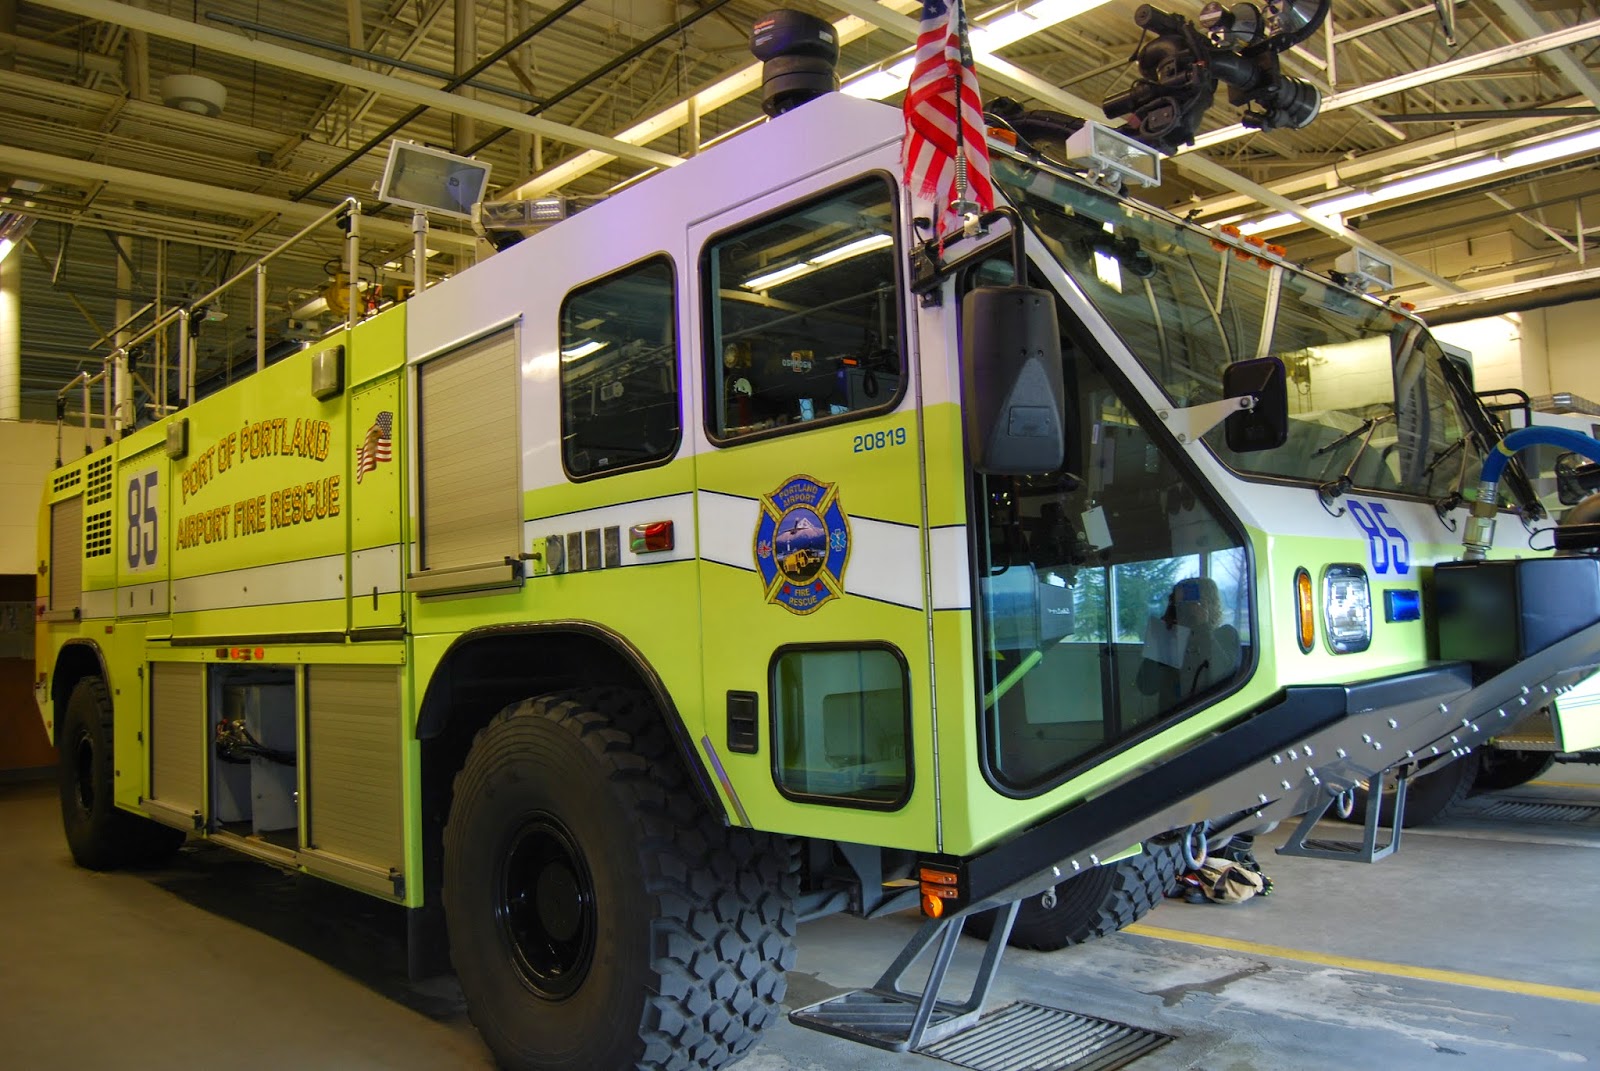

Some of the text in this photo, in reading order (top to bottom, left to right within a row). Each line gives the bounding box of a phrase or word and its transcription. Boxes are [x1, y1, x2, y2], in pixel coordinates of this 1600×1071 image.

[854, 427, 906, 453] 20819
[182, 418, 331, 505] PORT OF PORTLAND
[779, 483, 818, 499] PORTLAND
[783, 494, 816, 508] AIRPORT
[127, 470, 158, 568] 85
[176, 475, 340, 551] AIRPORT FIRE RESCUE
[1347, 500, 1410, 574] 85
[788, 596, 818, 607] RESCUE
[794, 588, 811, 597] FIRE
